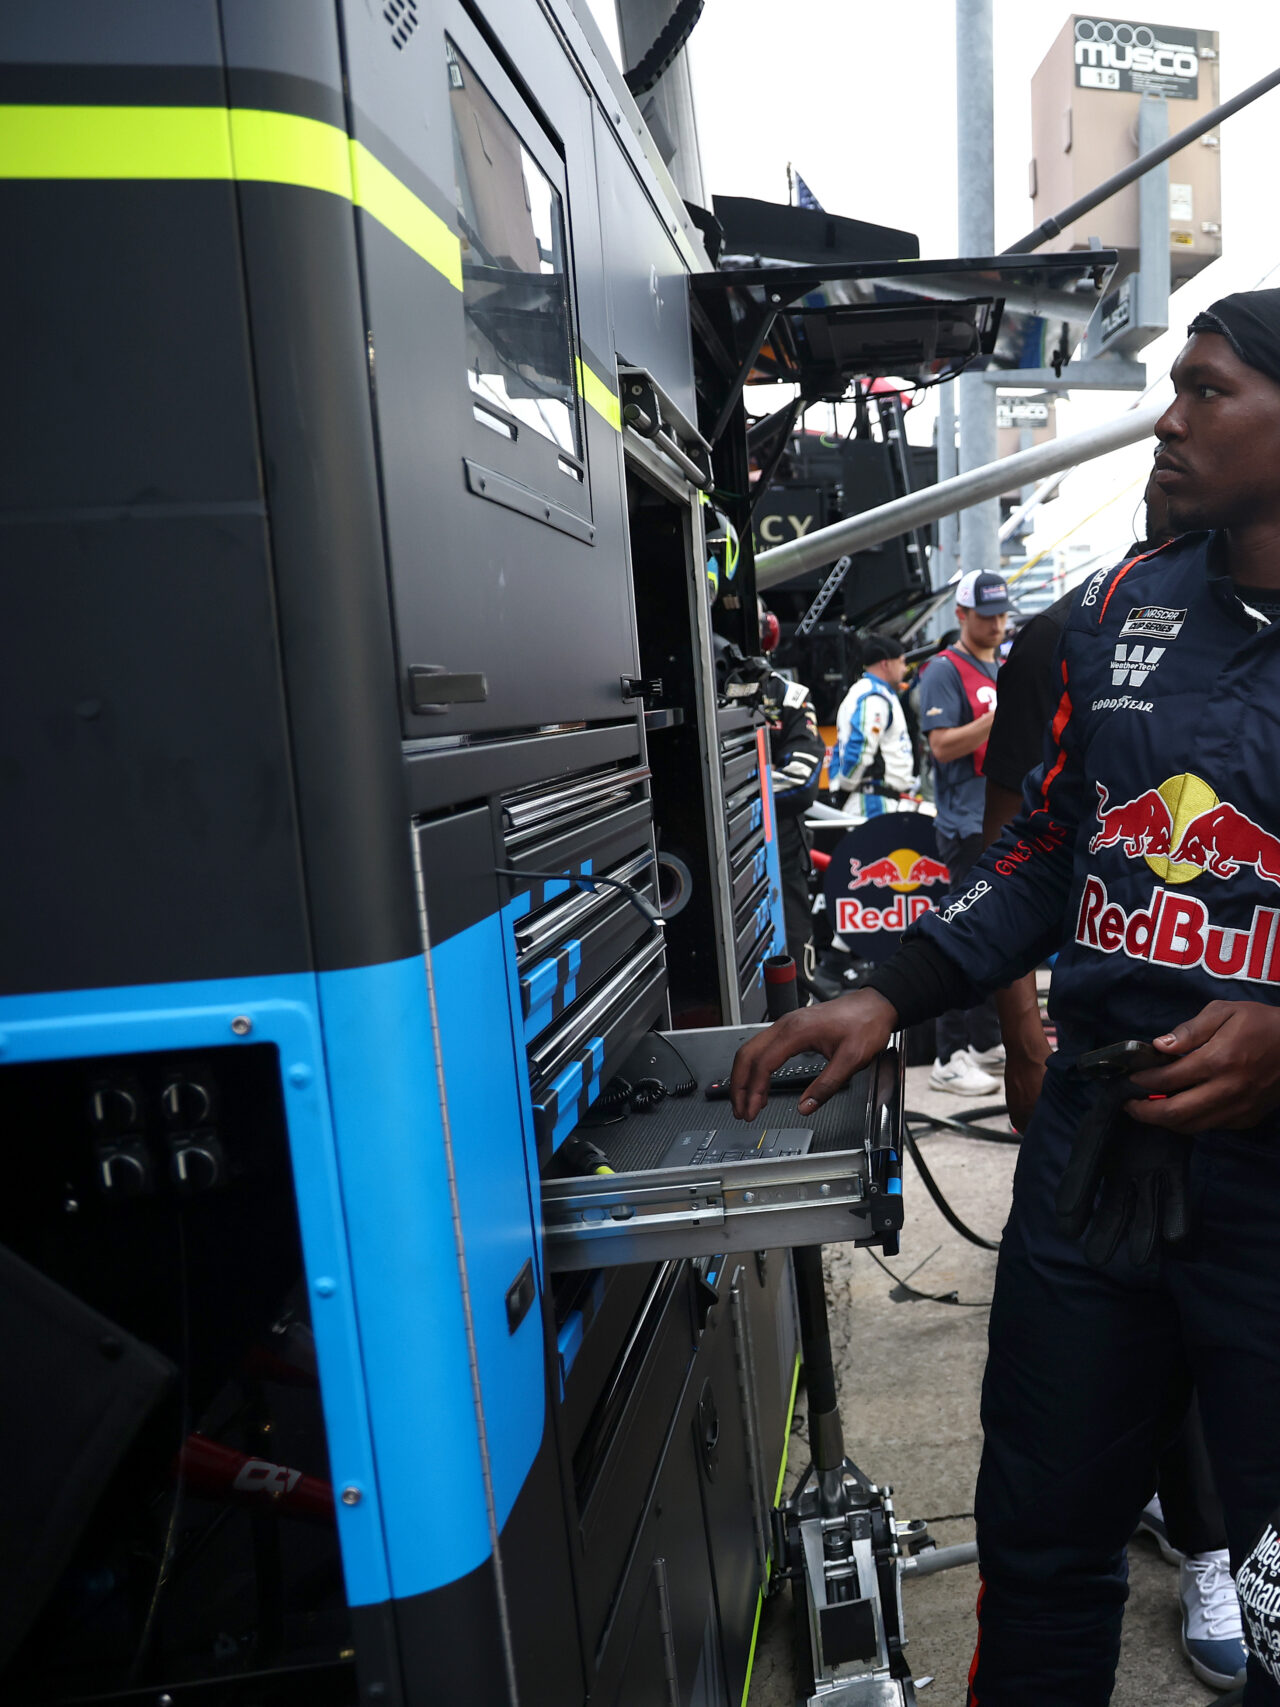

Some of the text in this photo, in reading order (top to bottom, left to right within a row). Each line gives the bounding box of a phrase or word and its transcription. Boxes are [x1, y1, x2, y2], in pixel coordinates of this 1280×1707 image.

[1092, 695, 1154, 712] GOODYEAR
[835, 894, 907, 934] Red
[1075, 874, 1164, 962] Red
